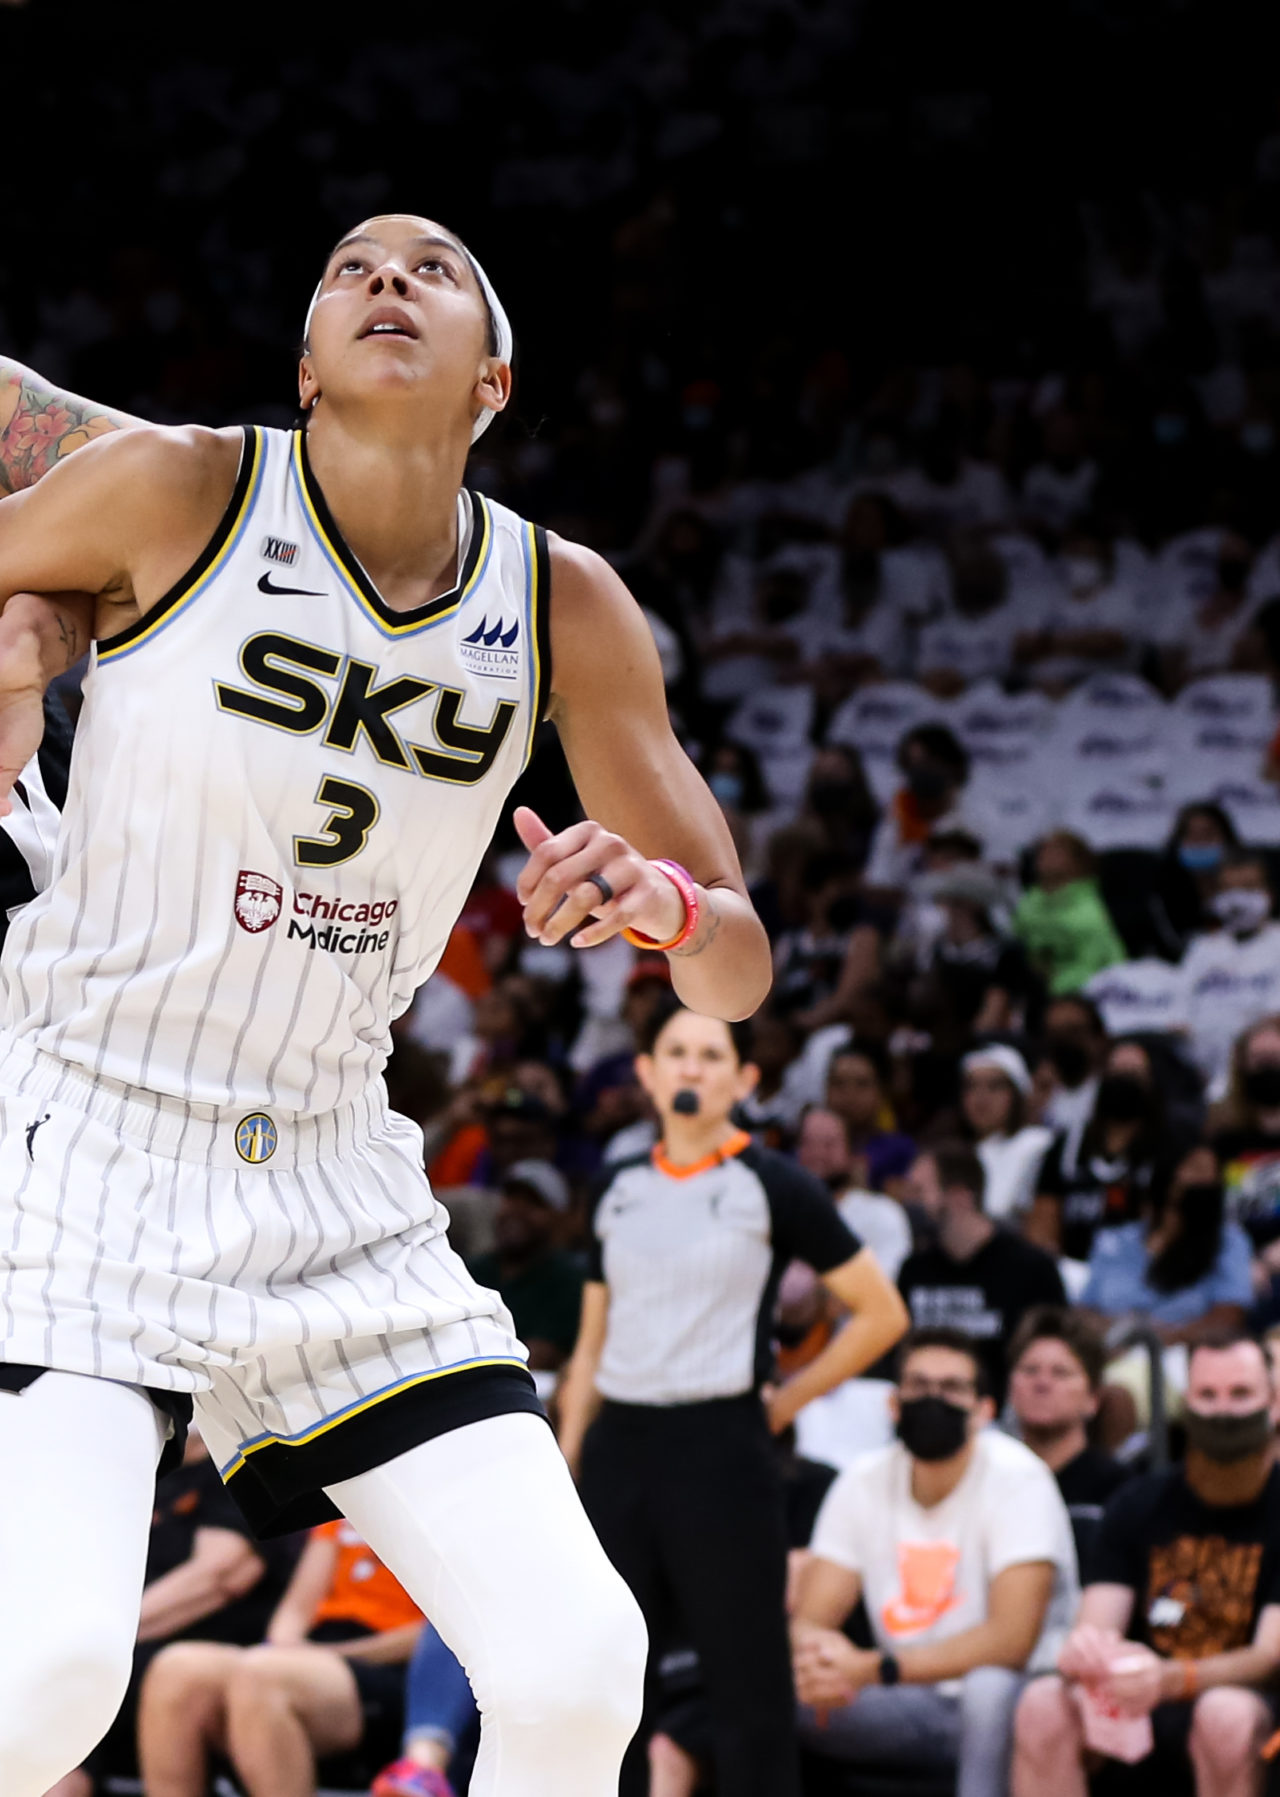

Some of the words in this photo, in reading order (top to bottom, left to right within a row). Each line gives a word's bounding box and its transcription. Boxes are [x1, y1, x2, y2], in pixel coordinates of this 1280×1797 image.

[460, 647, 519, 665] MAGELLAN
[212, 629, 520, 788] SKY
[292, 773, 380, 869] 3
[286, 919, 390, 955] Mdicine
